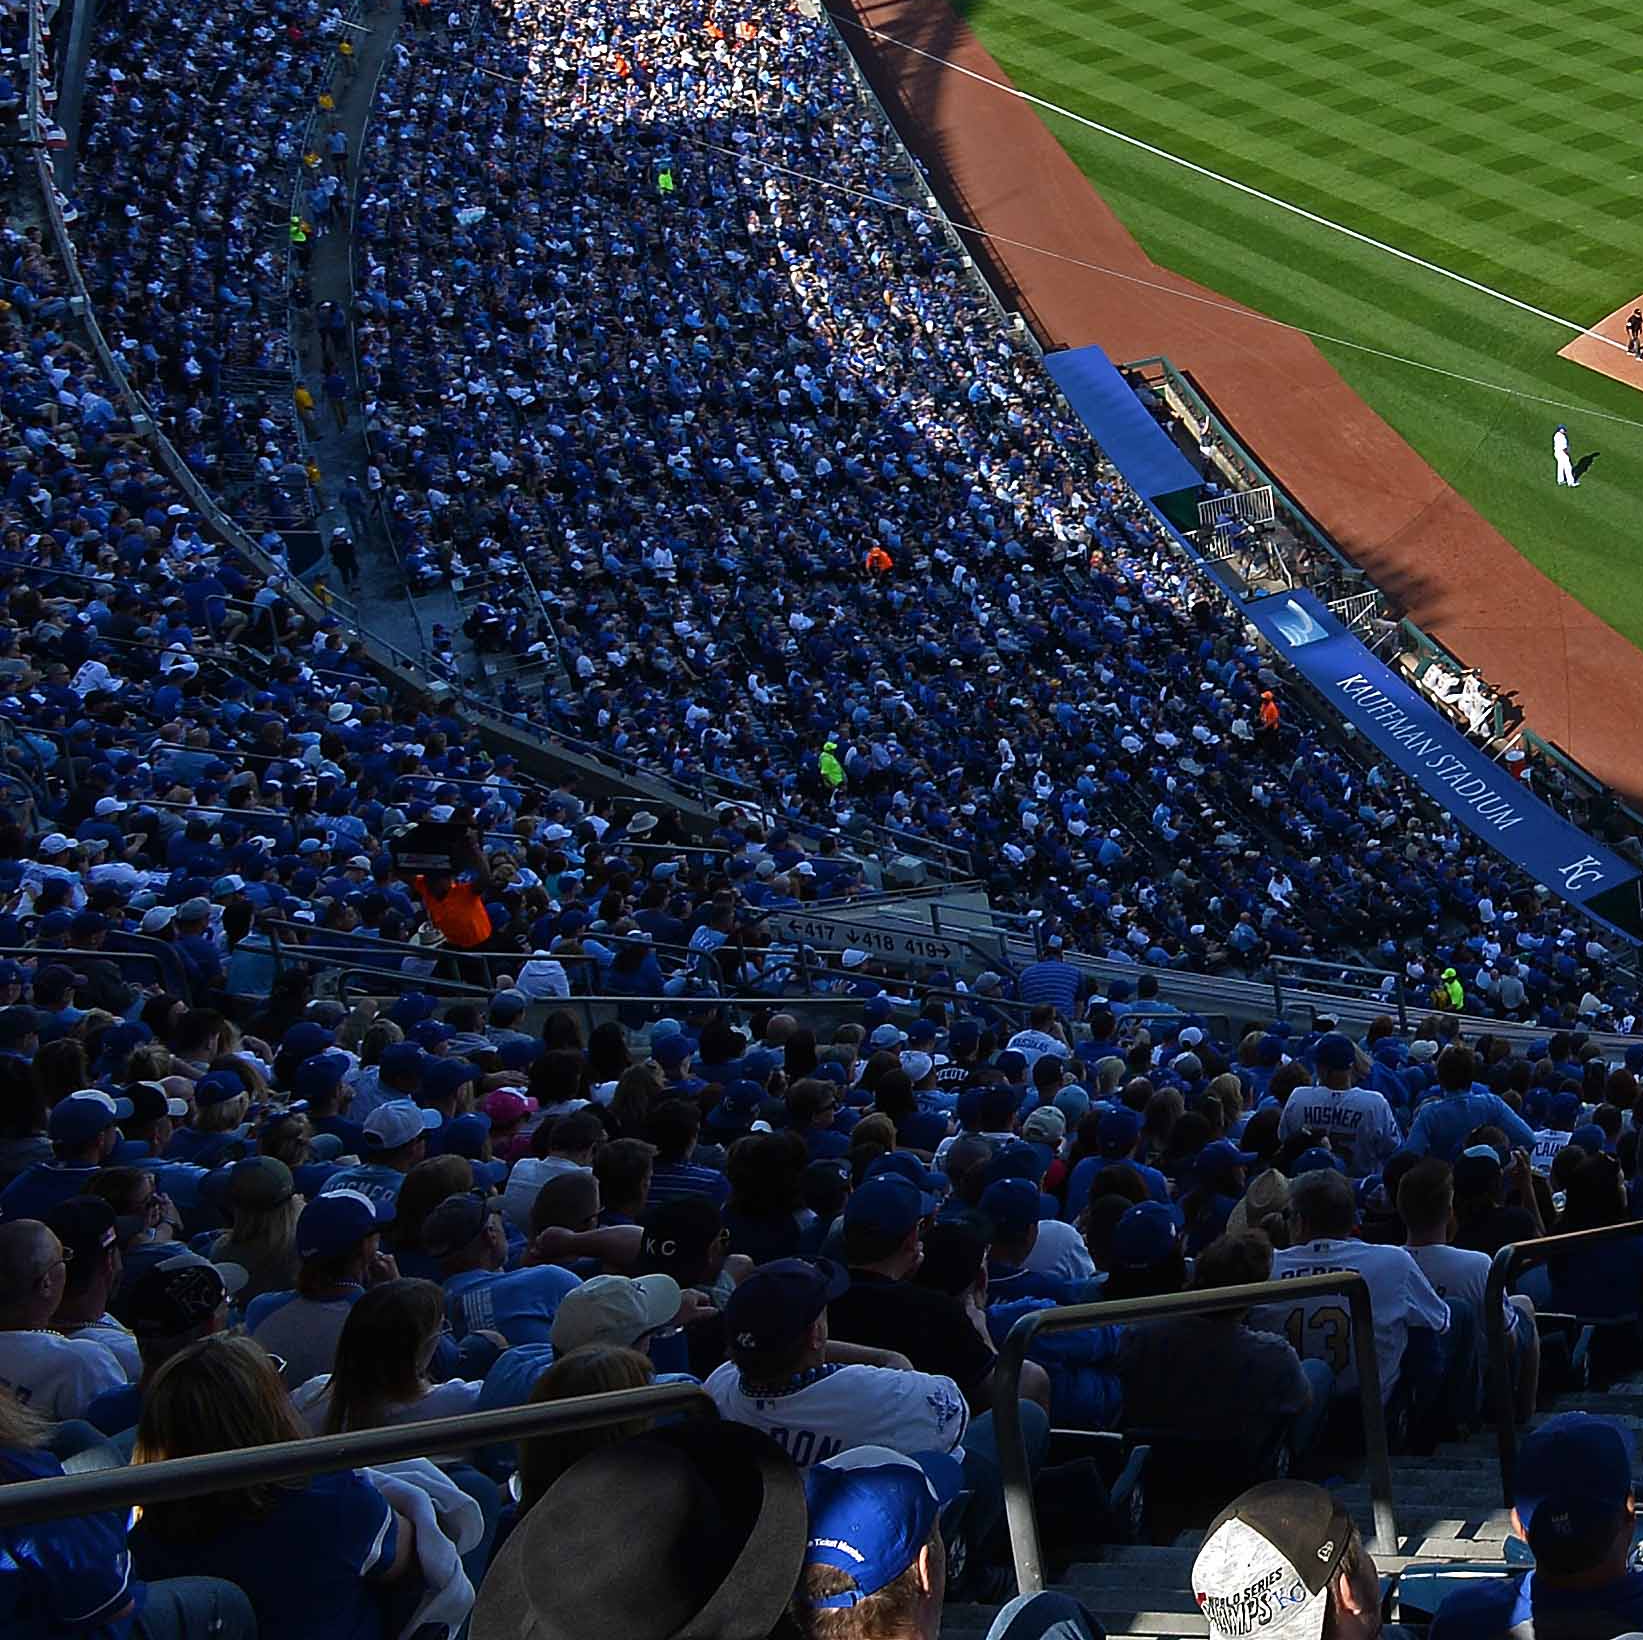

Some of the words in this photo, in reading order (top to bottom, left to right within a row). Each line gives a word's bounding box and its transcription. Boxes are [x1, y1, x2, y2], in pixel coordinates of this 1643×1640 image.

[1335, 673, 1441, 758] KAUFFMAN
[1425, 753, 1524, 832] STADIUM
[1558, 854, 1606, 891] KC
[805, 920, 836, 941] 417
[863, 932, 895, 952] 418
[905, 940, 938, 959] 419
[1303, 1105, 1363, 1130] HOSMER
[1243, 1566, 1283, 1600] SERIES
